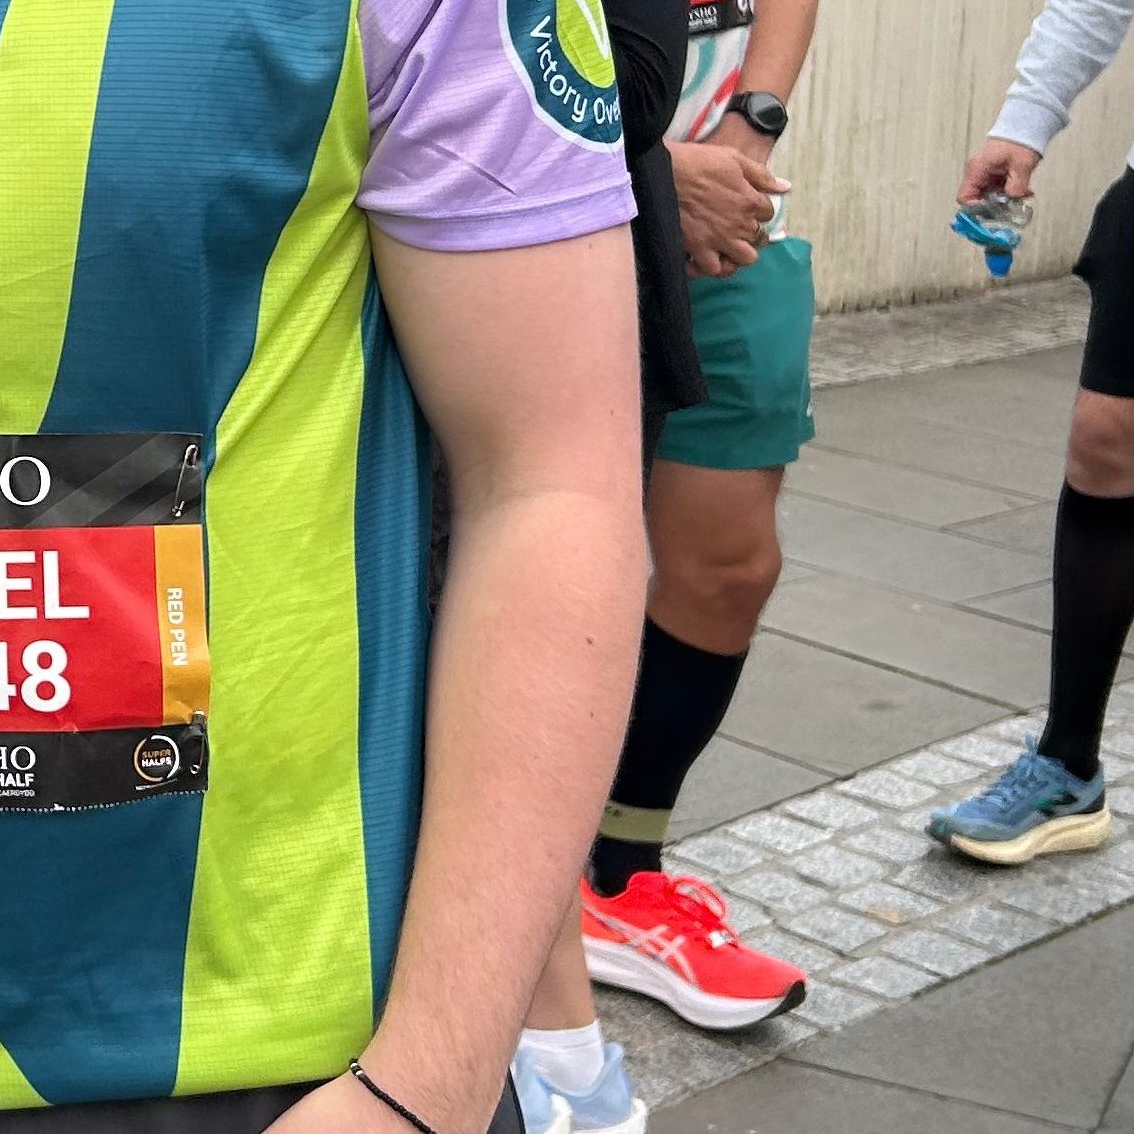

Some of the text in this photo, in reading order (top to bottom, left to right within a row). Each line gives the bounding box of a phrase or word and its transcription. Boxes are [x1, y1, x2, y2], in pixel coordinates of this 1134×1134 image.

[529, 15, 621, 125] Victory Ove
[166, 587, 188, 666] RED PEN
